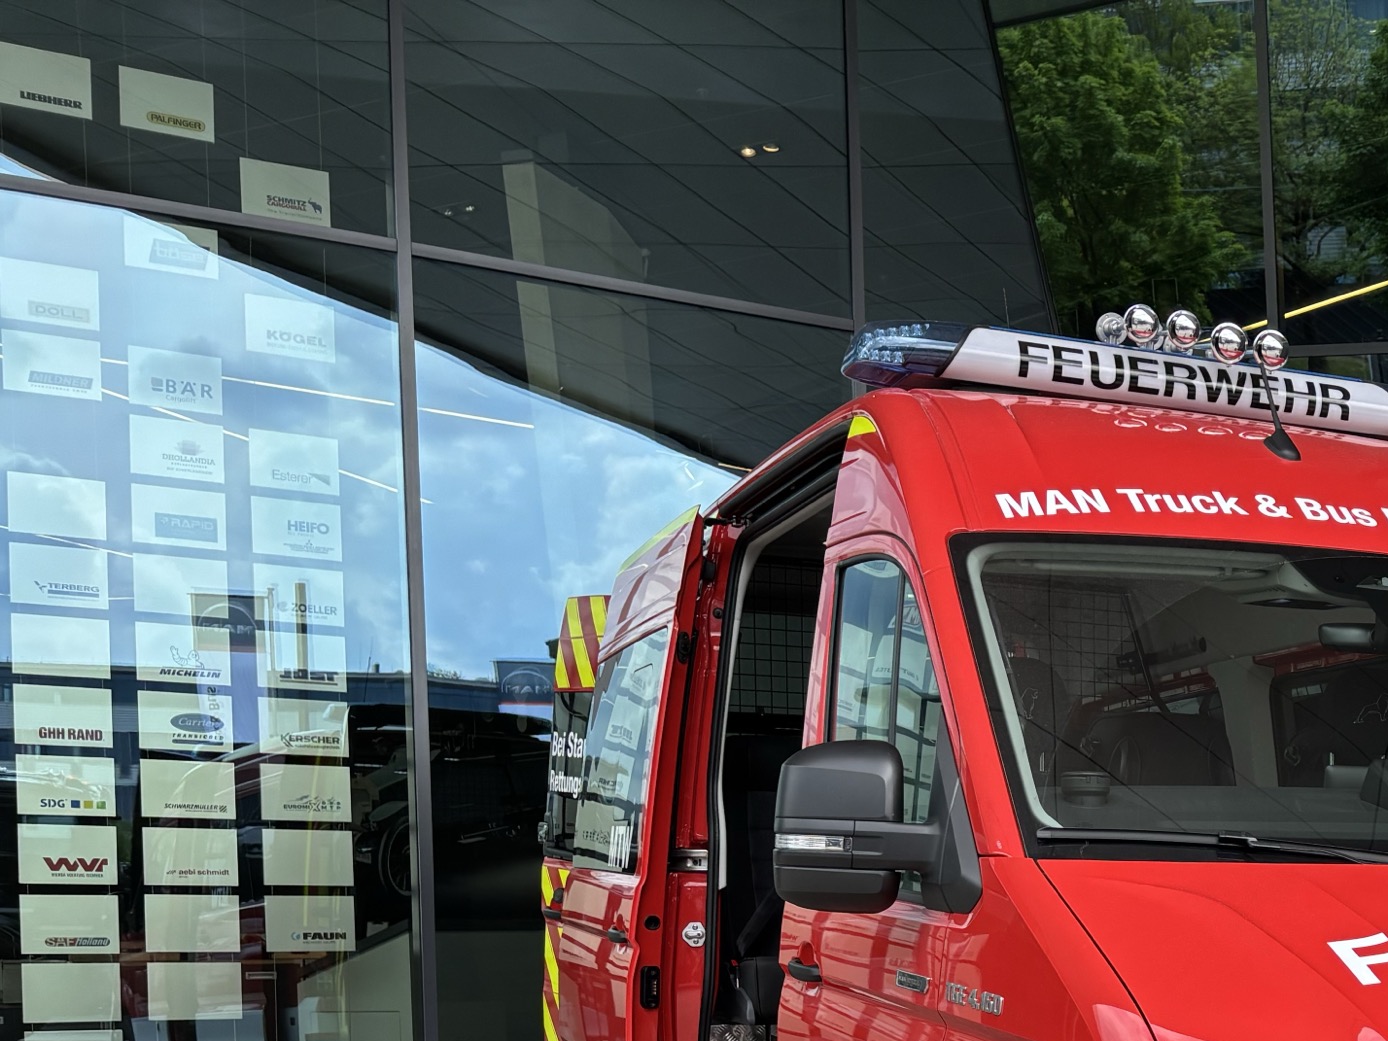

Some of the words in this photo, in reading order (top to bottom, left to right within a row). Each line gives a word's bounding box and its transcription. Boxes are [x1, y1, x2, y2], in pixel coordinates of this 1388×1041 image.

[20, 90, 83, 110] LIEBHERR
[150, 112, 202, 131] PALFINGER
[266, 194, 307, 206] SCHMITZ
[35, 305, 83, 320] DOLL
[266, 329, 328, 348] KÖGEL
[31, 371, 90, 389] MILDNER
[1017, 340, 1352, 422] FEUERWEHR
[165, 378, 213, 400] BÄR
[162, 453, 216, 466] DHOLLANDIA
[272, 468, 312, 485] Esterer
[995, 488, 1110, 519] MAN
[1116, 487, 1250, 518] Truck
[1256, 492, 1293, 520] &
[1294, 496, 1379, 529] Bus
[170, 518, 214, 531] RAPID
[287, 519, 330, 535] HEIFO
[48, 582, 100, 593] TERBERG
[291, 602, 338, 616] ZOELLER
[159, 667, 221, 679] MICHELIN
[39, 726, 65, 740] GHH
[67, 727, 103, 742] RAND
[280, 732, 340, 748] KERSCHER
[551, 731, 566, 757] Bei
[567, 732, 586, 760] Sta
[40, 798, 66, 808] SDG
[302, 932, 347, 941] FAUN
